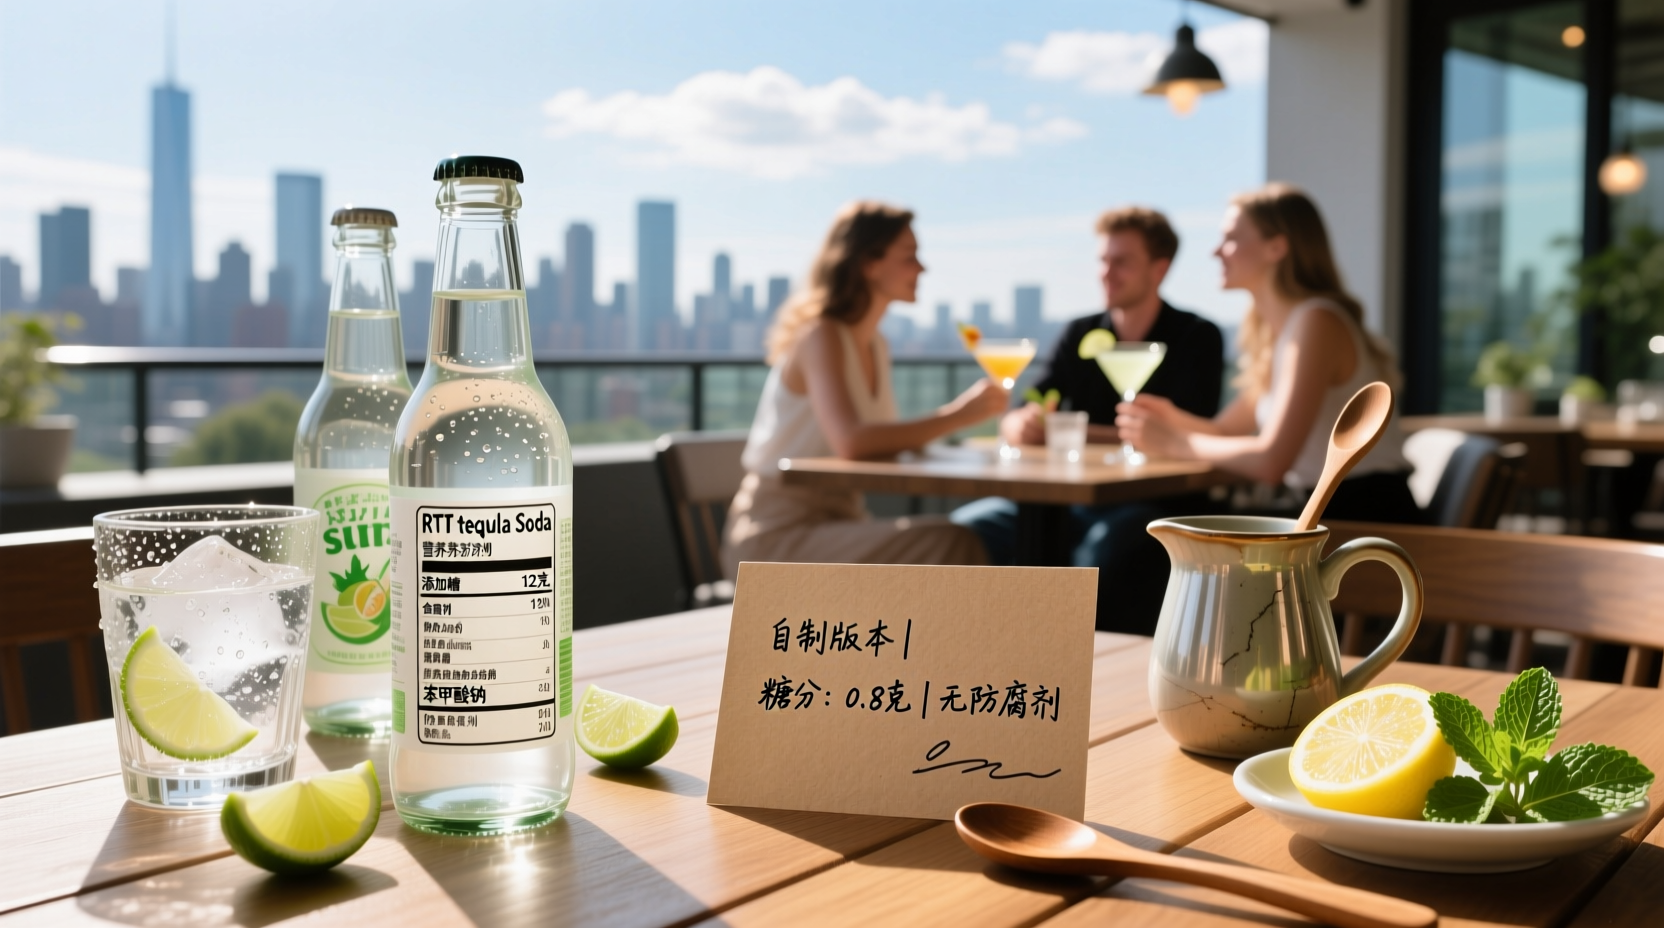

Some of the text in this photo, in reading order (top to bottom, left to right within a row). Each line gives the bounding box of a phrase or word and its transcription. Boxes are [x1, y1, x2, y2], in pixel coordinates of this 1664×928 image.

[422, 510, 552, 539] RTT tequla Soda
